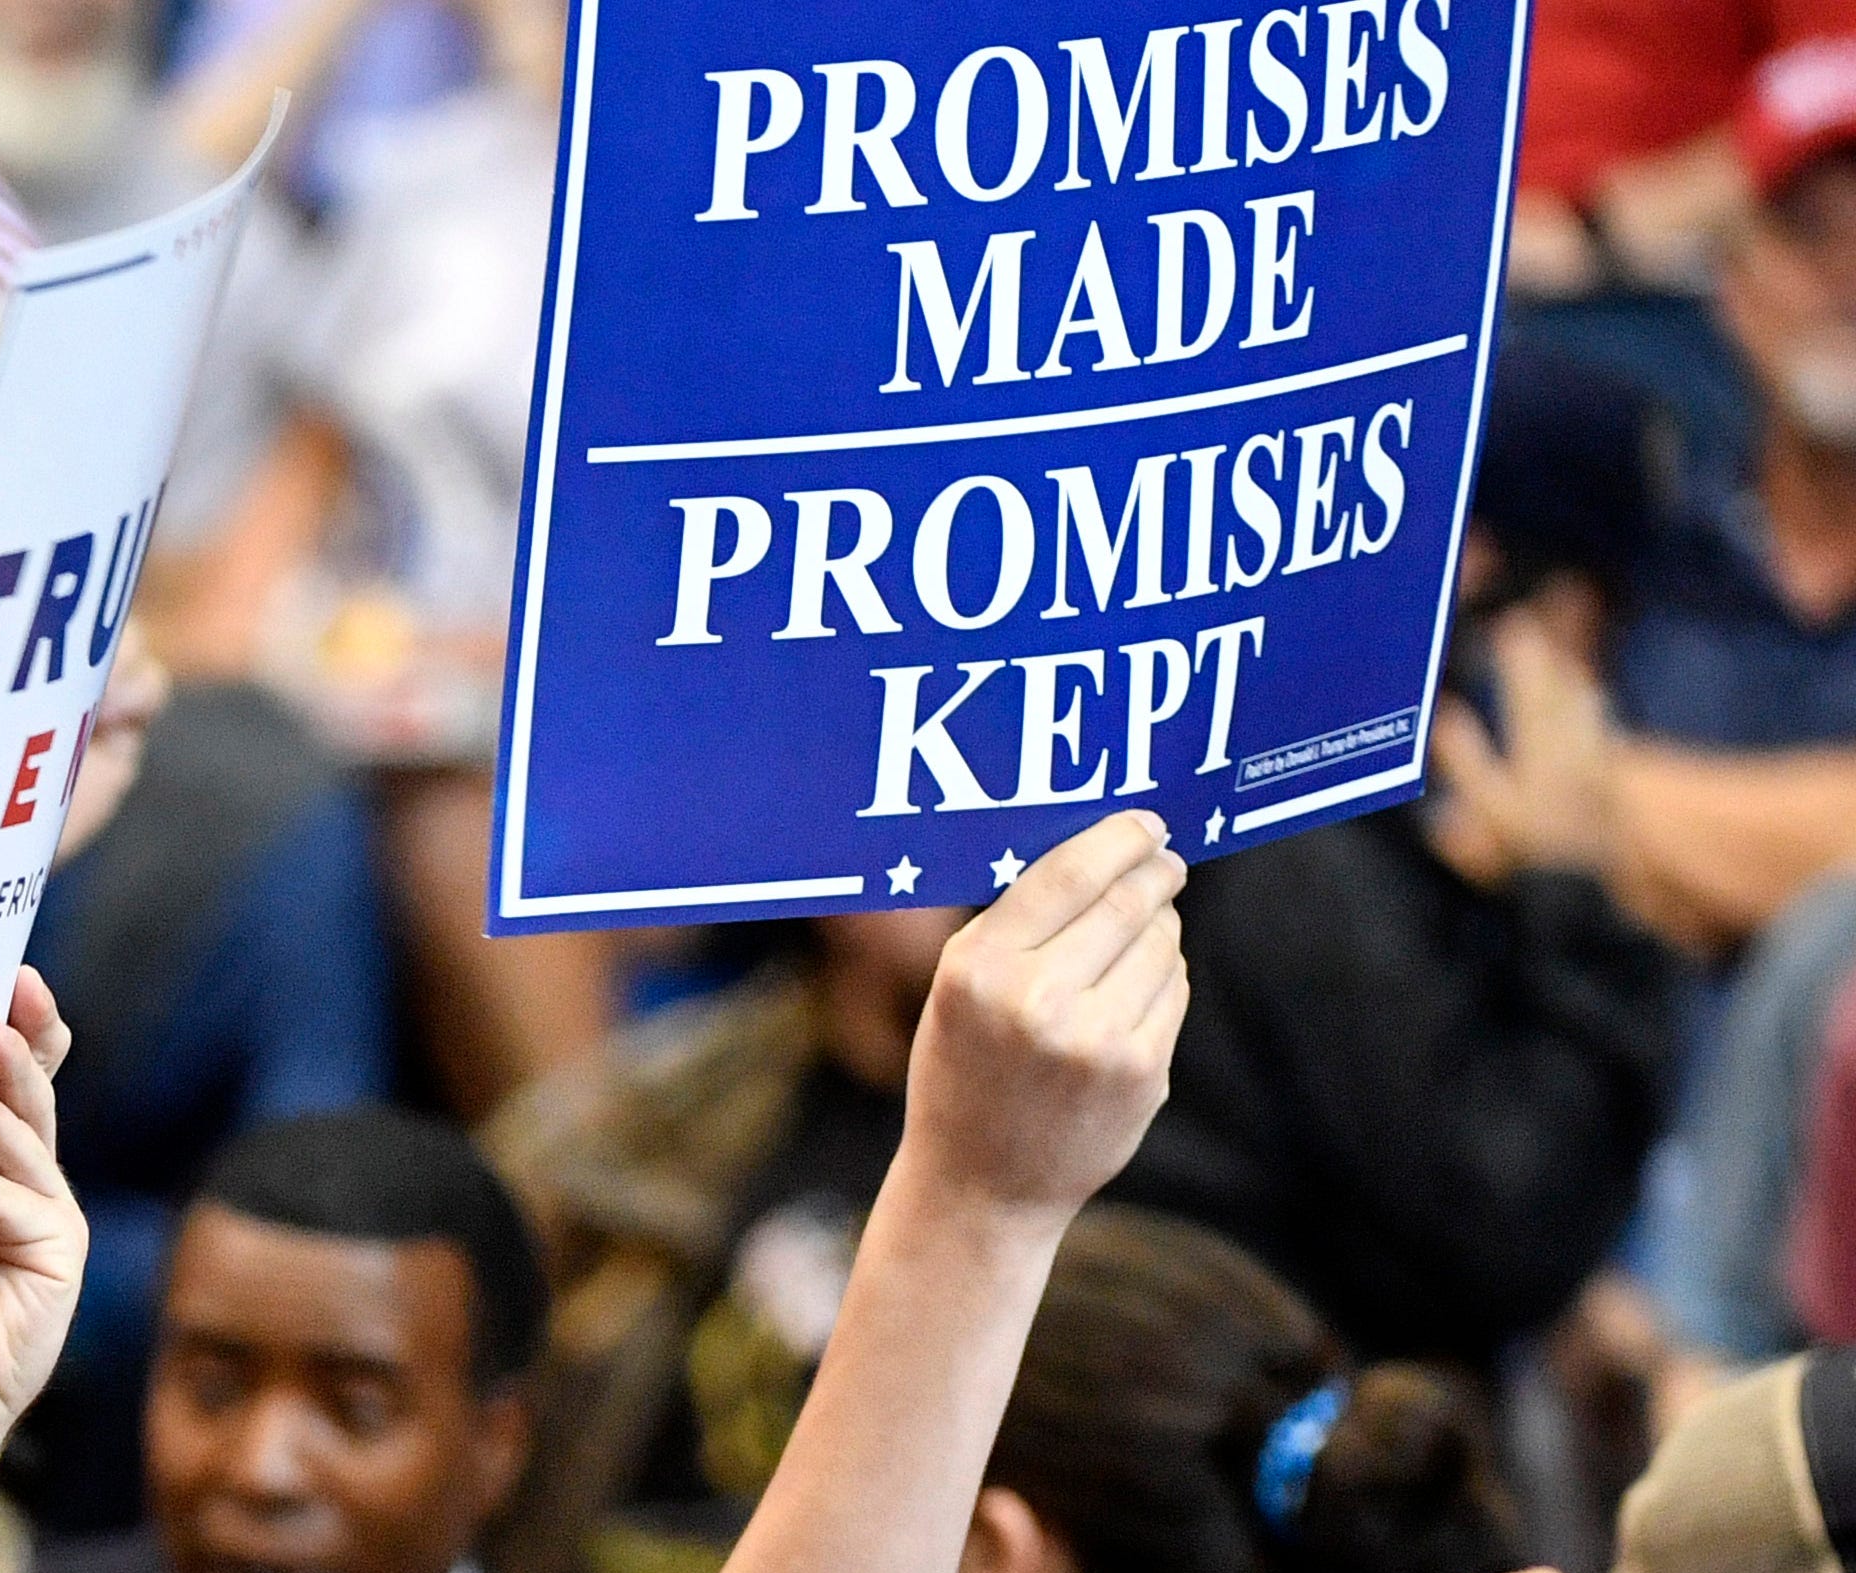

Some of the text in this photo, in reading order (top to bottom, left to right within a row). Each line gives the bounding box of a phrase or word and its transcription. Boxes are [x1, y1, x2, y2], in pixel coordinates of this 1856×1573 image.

[694, 0, 1452, 223] PROMISES
[878, 190, 1316, 394] MADE
[654, 397, 1415, 648] PROMISES
[854, 614, 1266, 818] KEPT
